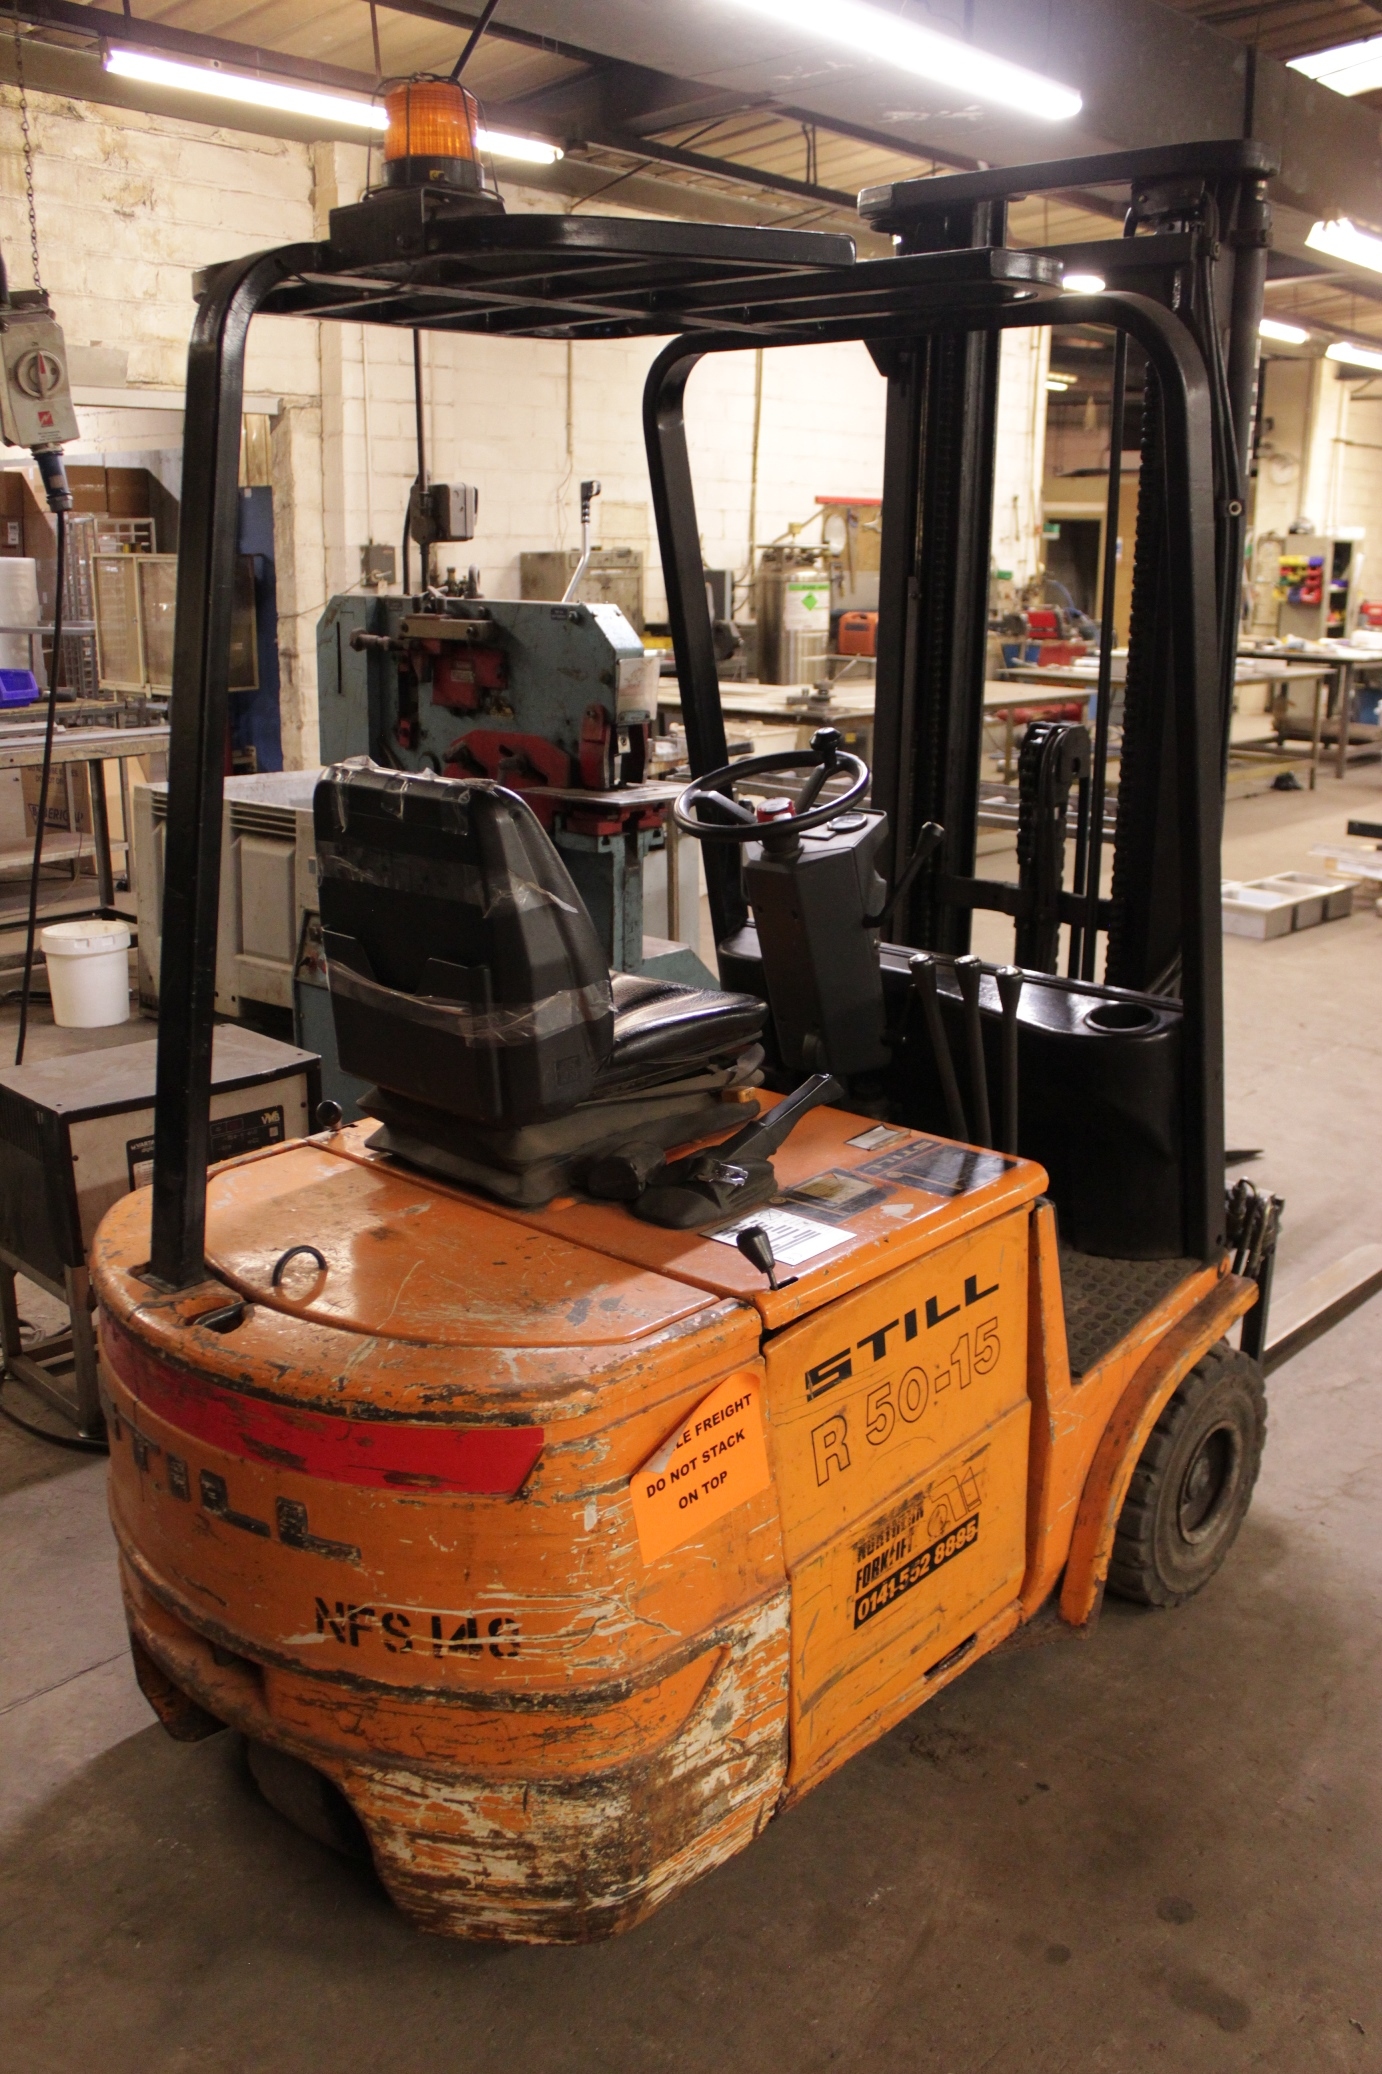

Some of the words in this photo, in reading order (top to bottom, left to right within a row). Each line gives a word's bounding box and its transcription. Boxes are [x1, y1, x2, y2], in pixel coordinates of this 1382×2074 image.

[804, 1274, 999, 1402] STILL
[694, 1393, 752, 1437] FREIGHT
[810, 1414, 851, 1488] R
[865, 1316, 1001, 1446] 50-15
[646, 1478, 666, 1498] DO
[670, 1457, 698, 1483] NOT
[701, 1428, 746, 1464] STACK
[678, 1489, 699, 1510] ON
[701, 1470, 728, 1495] TOP
[315, 1596, 413, 1654] NFS
